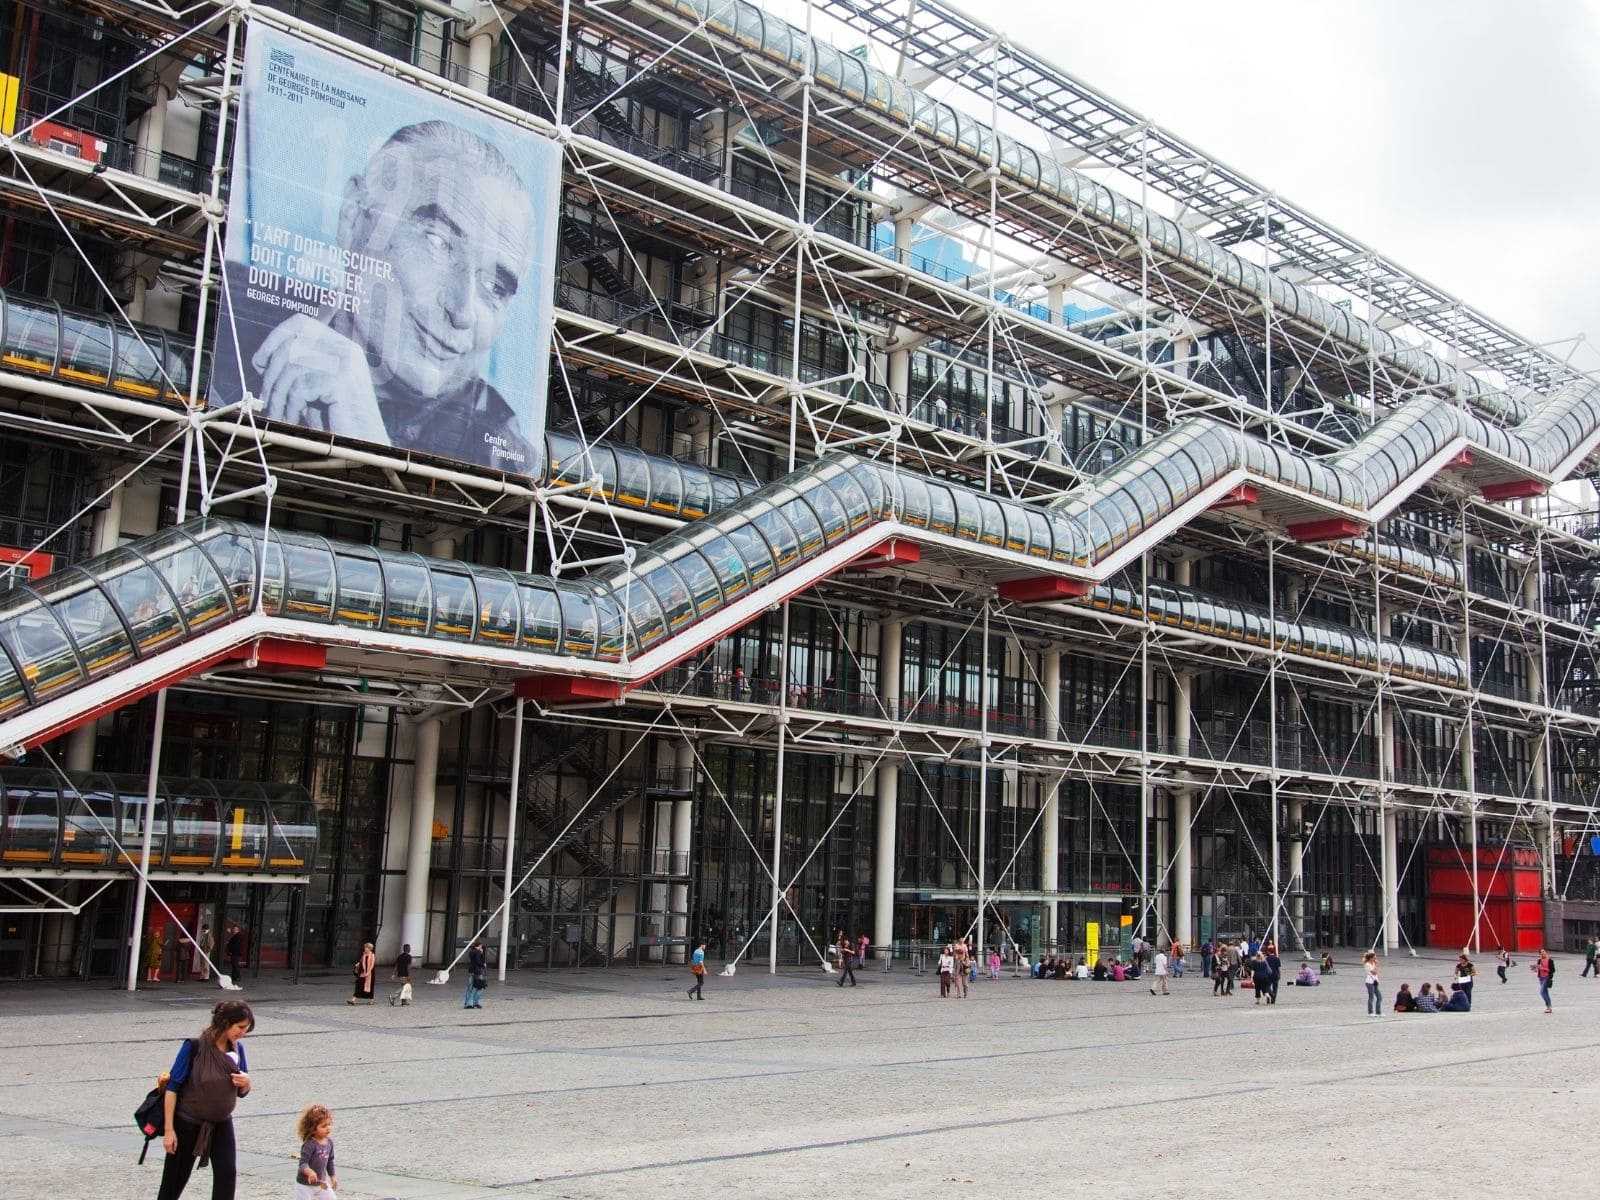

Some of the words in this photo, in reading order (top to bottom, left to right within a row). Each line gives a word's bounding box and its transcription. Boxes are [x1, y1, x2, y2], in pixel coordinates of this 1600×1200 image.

[267, 72, 277, 84] DE
[278, 77, 310, 96] GEORGES
[310, 89, 345, 109] POMPIDOU
[267, 83, 303, 104] 1911-2011
[269, 61, 310, 86] CENTENAIRE
[311, 78, 321, 90] DE
[321, 82, 330, 94] LA
[331, 85, 368, 107] NAISSANCE
[251, 243, 284, 270] DOIT
[286, 254, 367, 295] CONTESTER.
[294, 234, 327, 259] DOIT
[329, 245, 395, 283] DISCUTER.
[248, 265, 282, 291] DOIT
[246, 287, 280, 306] GEORGES
[281, 298, 319, 317] POMPIDOU
[484, 432, 507, 447] Centre
[492, 445, 525, 463] Pompidou
